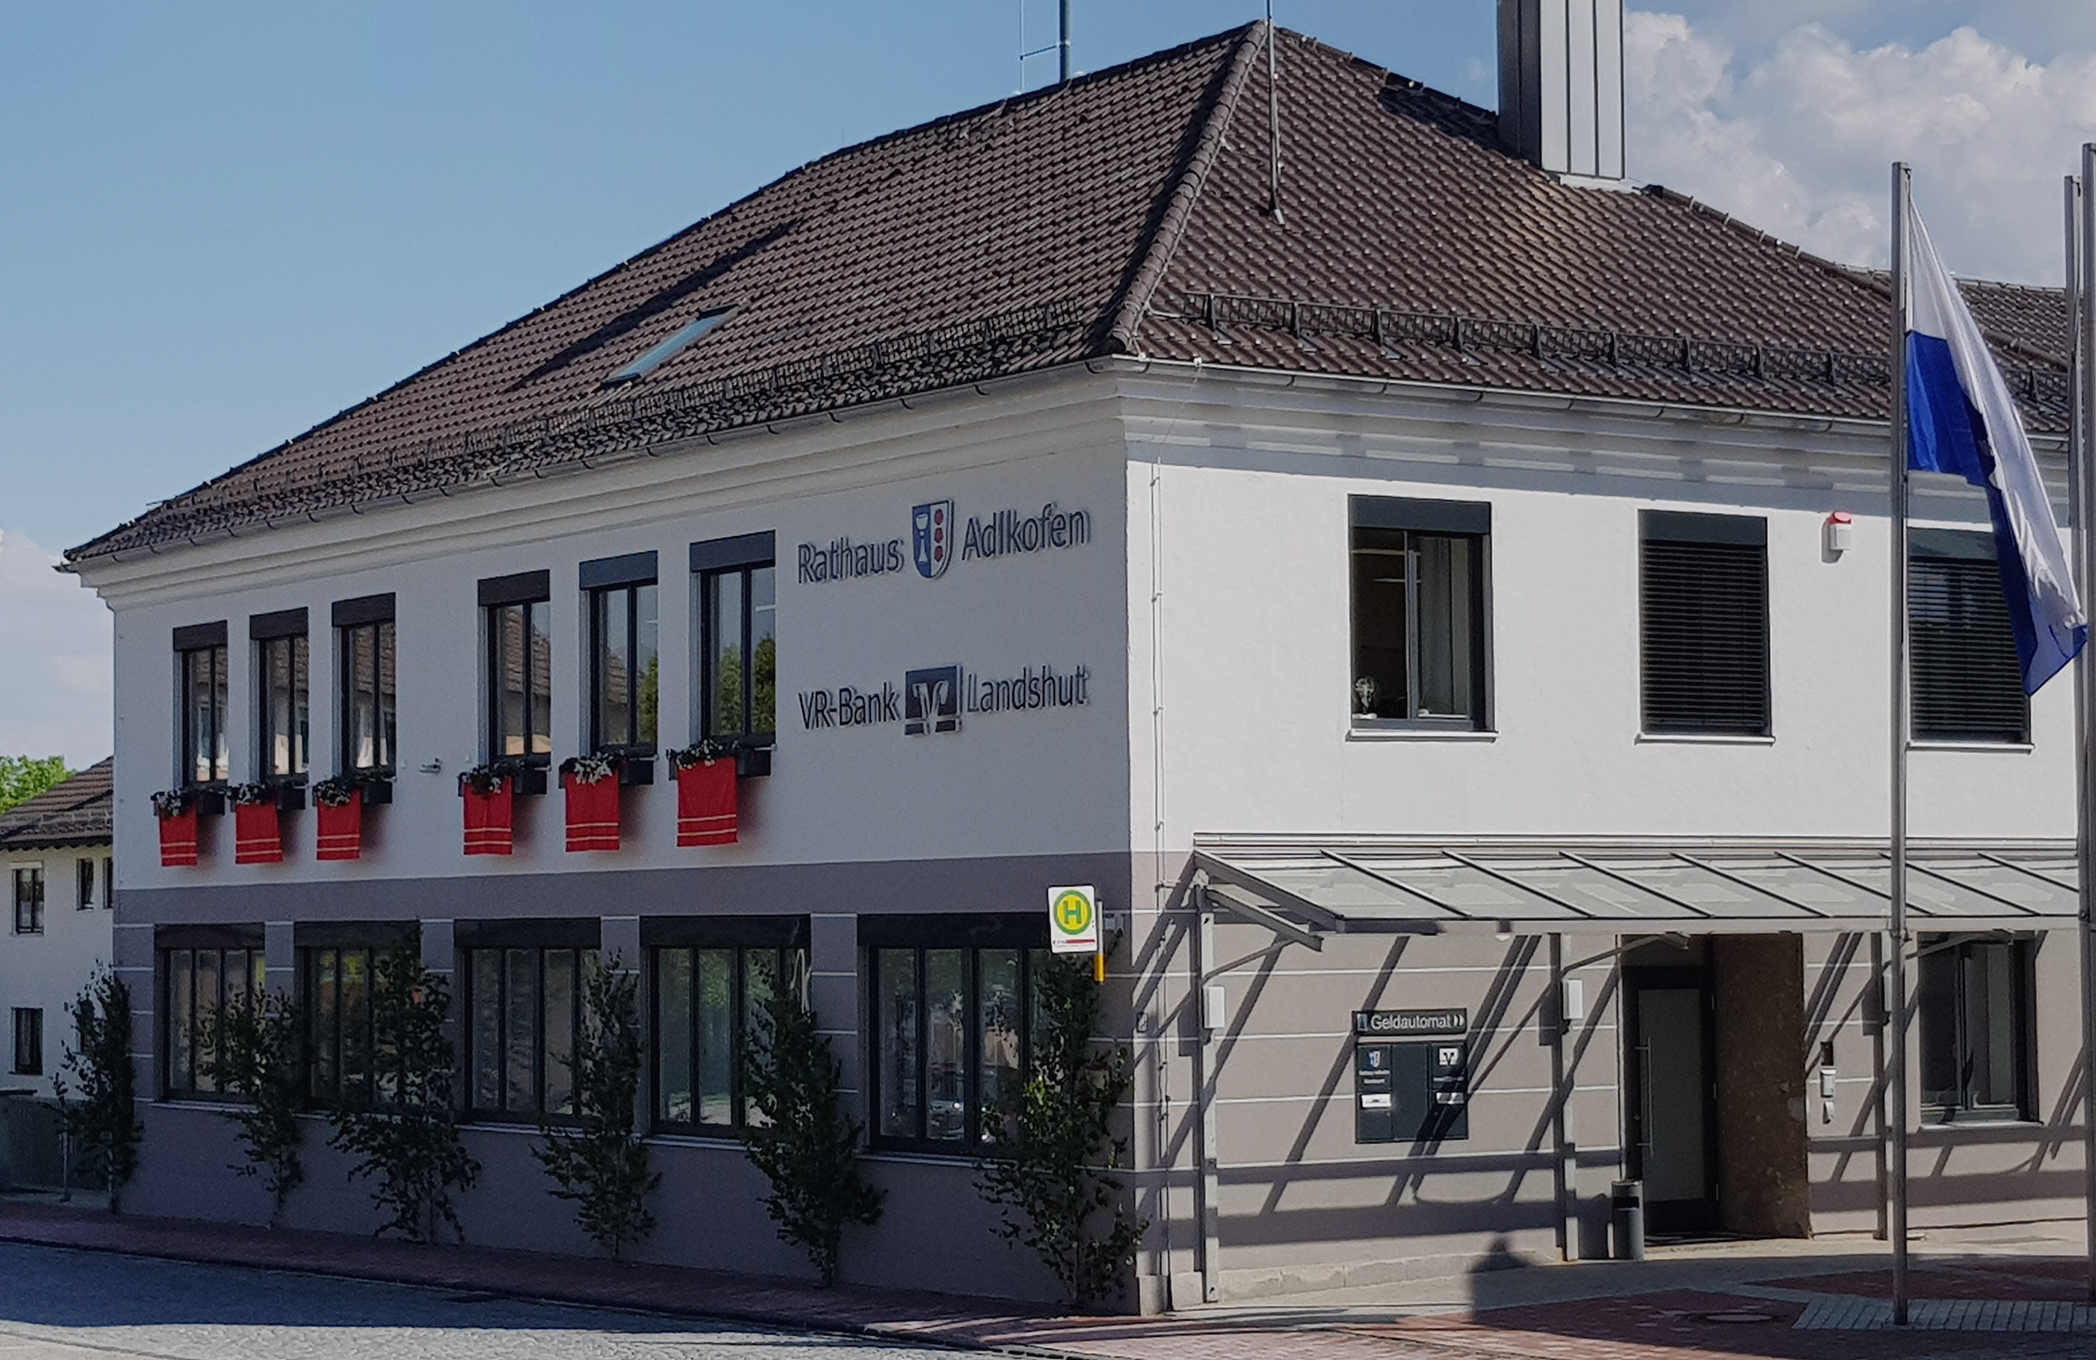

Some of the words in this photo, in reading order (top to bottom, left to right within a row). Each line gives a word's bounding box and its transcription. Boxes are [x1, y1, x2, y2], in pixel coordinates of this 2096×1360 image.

[798, 537, 903, 583] Rathaus
[962, 504, 1091, 560] Adlkofen
[798, 682, 900, 729] VR-Bank
[967, 666, 1089, 713] Landshut
[1063, 900, 1082, 924] H
[1370, 1014, 1452, 1030] Geldautomat
